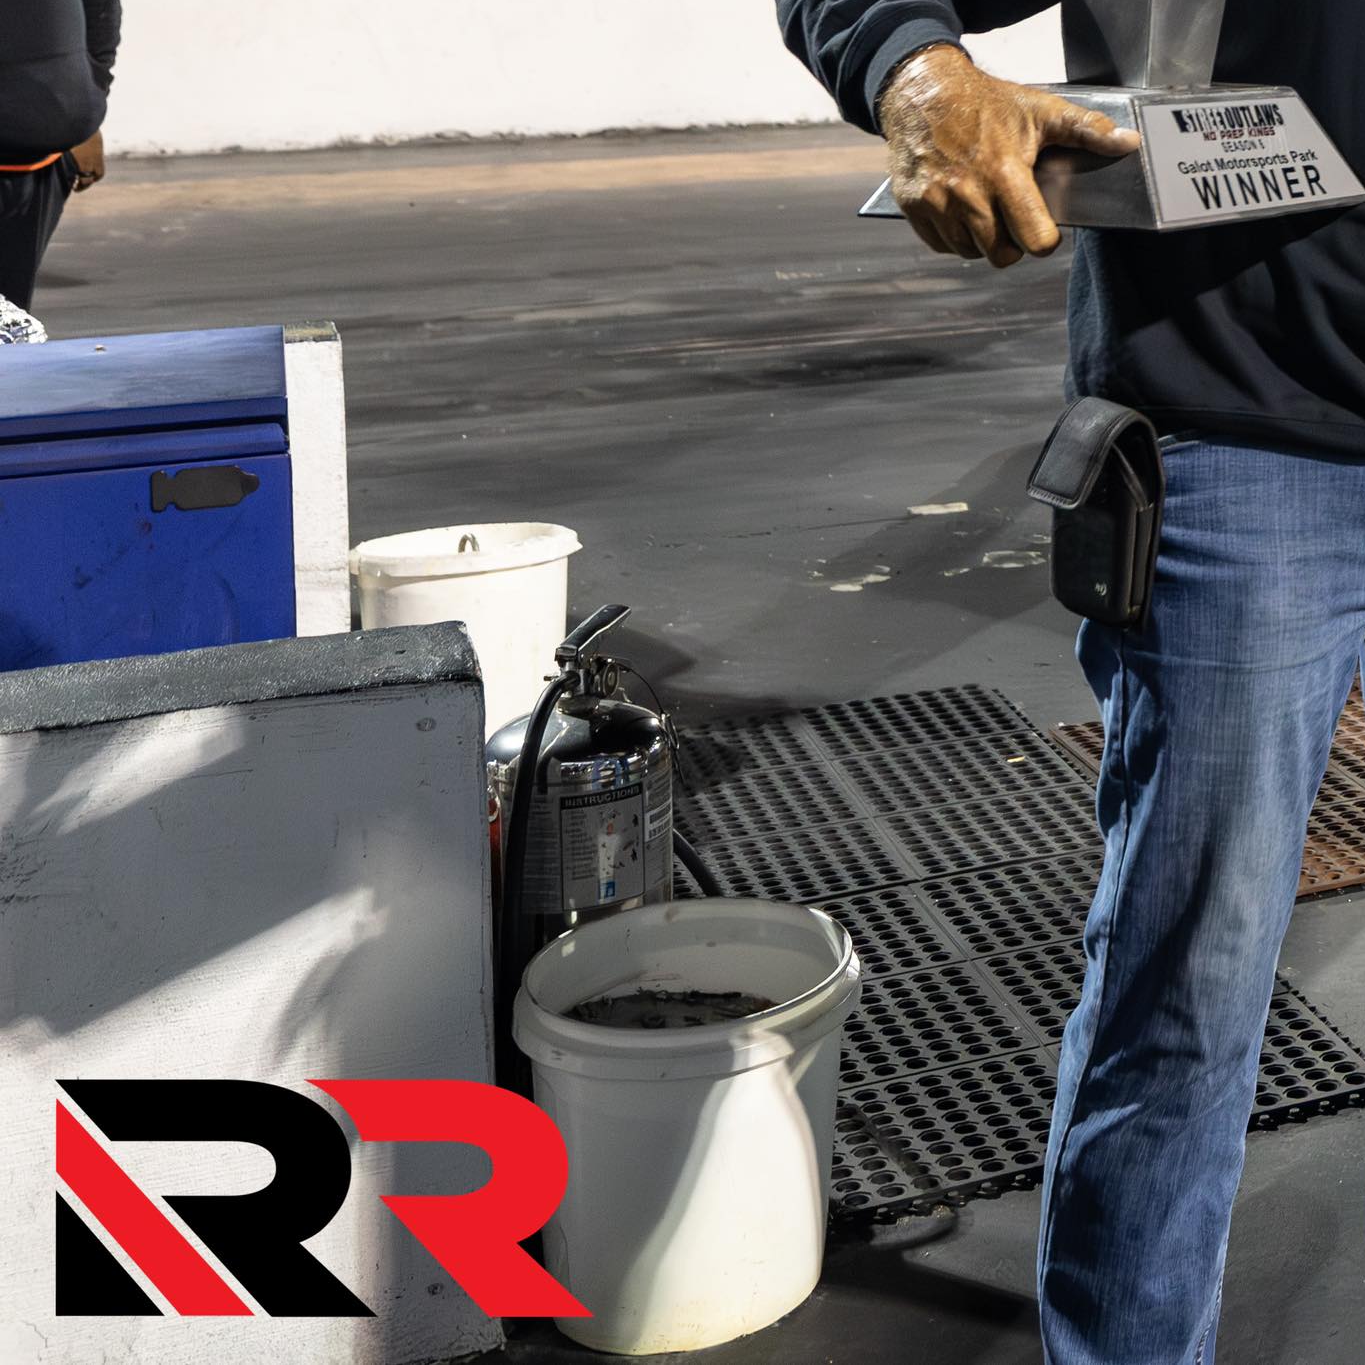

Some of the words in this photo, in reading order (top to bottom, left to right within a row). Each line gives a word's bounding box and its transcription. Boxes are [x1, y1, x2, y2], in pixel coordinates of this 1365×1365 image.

[1203, 131, 1217, 142] NO
[1219, 129, 1245, 141] PREP
[1249, 126, 1276, 138] KINGS
[1221, 139, 1257, 153] SEASON
[1177, 160, 1213, 175] Galot
[1214, 153, 1289, 171] Motorsports
[1289, 148, 1318, 164] Park
[1191, 164, 1327, 211] WINNER
[564, 786, 640, 808] INSTRUCTIONS
